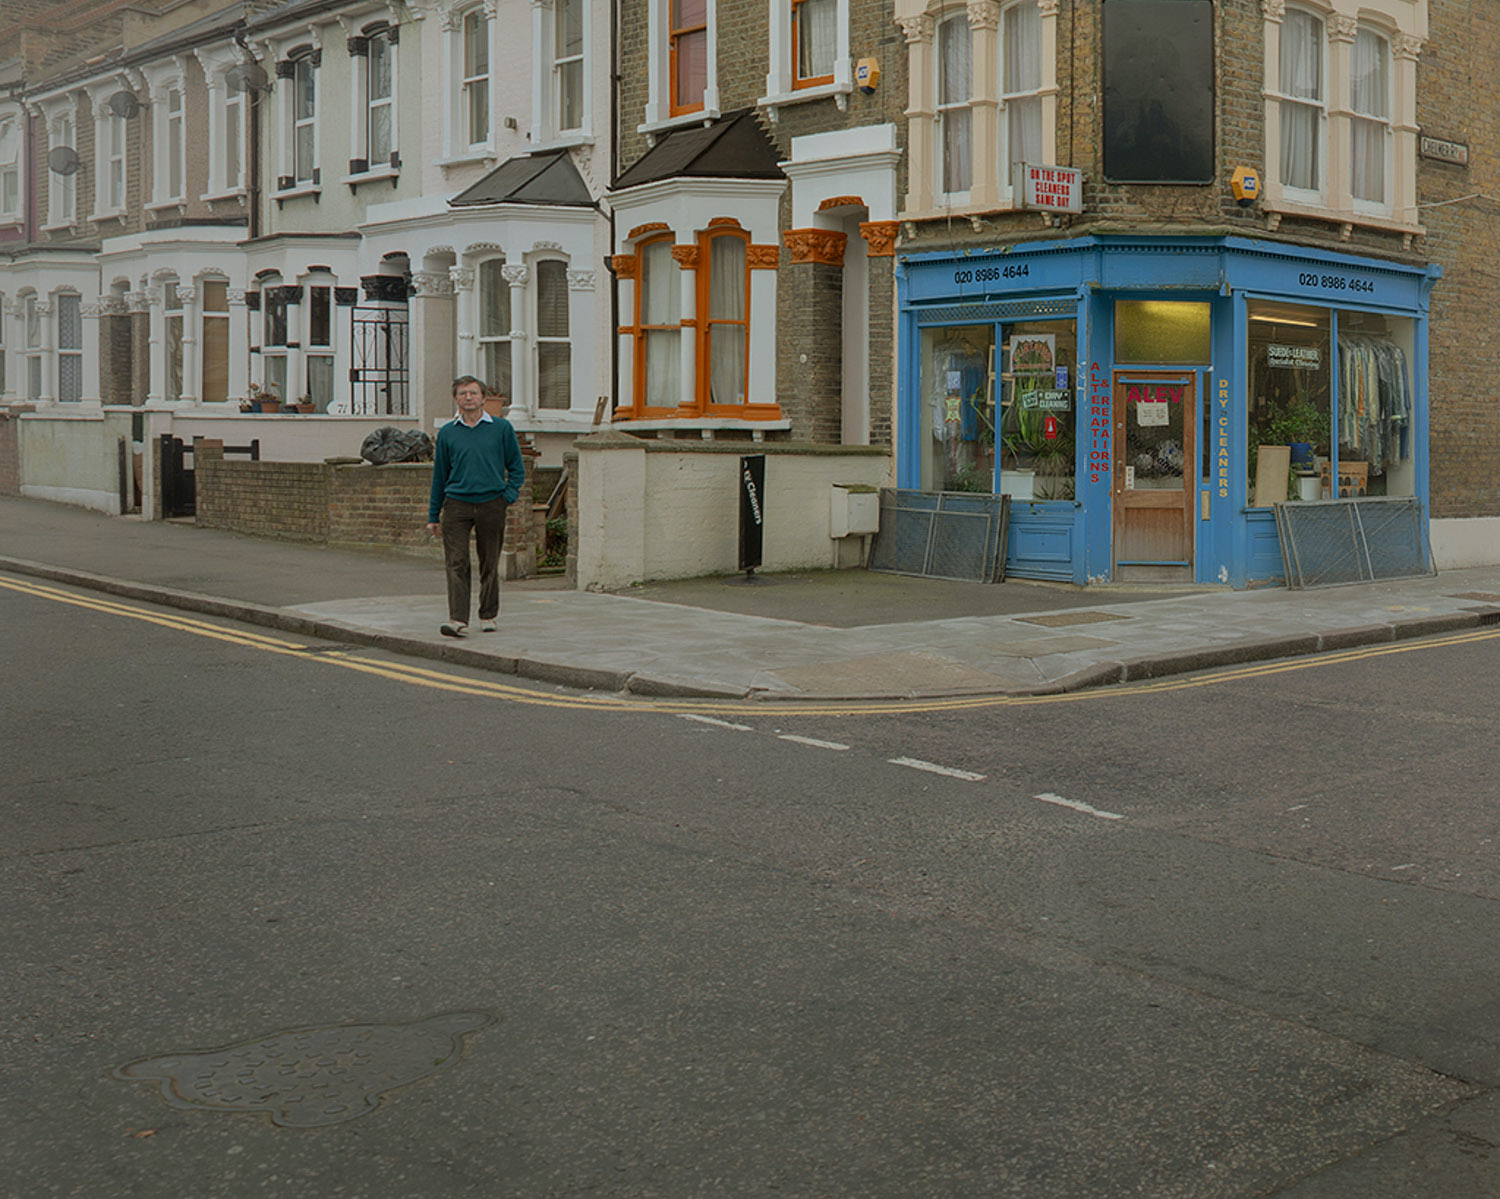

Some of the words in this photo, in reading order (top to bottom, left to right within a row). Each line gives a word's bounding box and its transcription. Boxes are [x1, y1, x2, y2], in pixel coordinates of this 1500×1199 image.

[1423, 138, 1450, 157] CHELMER
[1031, 169, 1040, 179] ON
[1042, 170, 1054, 182] THE
[1056, 171, 1075, 184] SPOT
[1036, 181, 1069, 196] CLEANERS
[1036, 194, 1054, 206] SAME
[1056, 196, 1069, 208] DAY
[954, 270, 973, 284] 020
[975, 267, 1000, 282] 8986
[1002, 264, 1029, 279] 4644
[1299, 273, 1318, 287] 020
[1321, 275, 1346, 290] 8986
[1348, 279, 1374, 293] 4644
[1101, 379, 1109, 388] &
[1045, 392, 1062, 400] DRY
[1128, 387, 1183, 403] ALEV
[1219, 380, 1229, 408] DRY
[1040, 400, 1069, 408] CLEANING
[1090, 362, 1100, 483] ALTERATIONS
[1101, 396, 1109, 472] REPAIRS
[1219, 417, 1228, 497] CLEANERS
[747, 482, 762, 525] Cleaners
